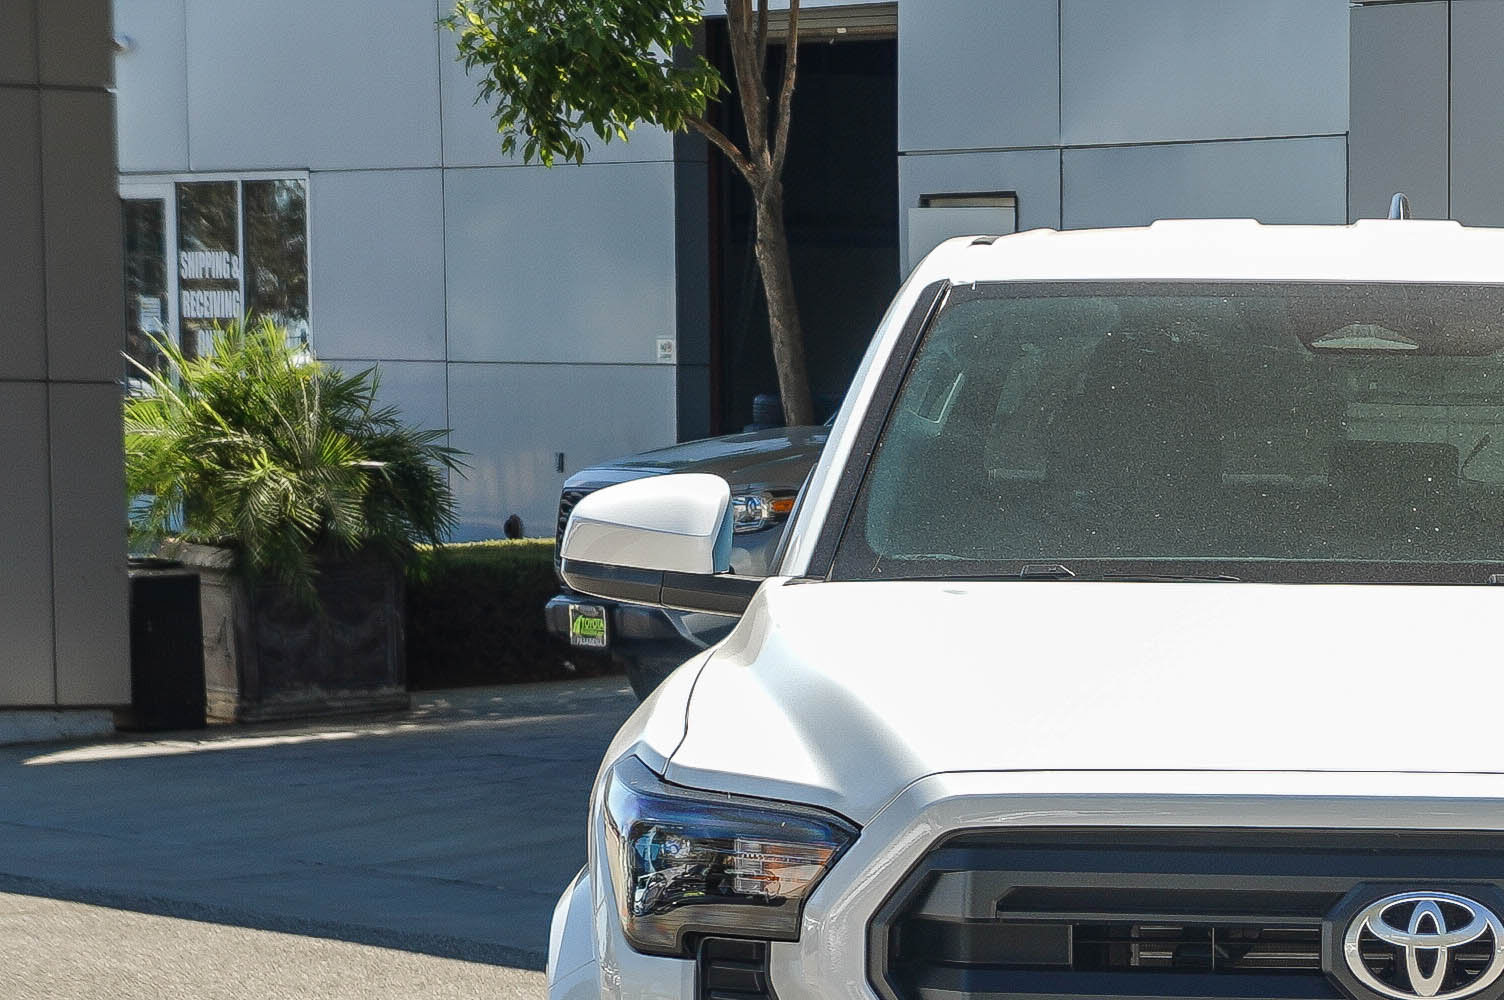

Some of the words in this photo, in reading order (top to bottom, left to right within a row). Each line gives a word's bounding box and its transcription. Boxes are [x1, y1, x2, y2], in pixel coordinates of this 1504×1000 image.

[180, 251, 230, 279] SHIPPING
[231, 254, 240, 279] &
[182, 289, 240, 318] RECEIVING
